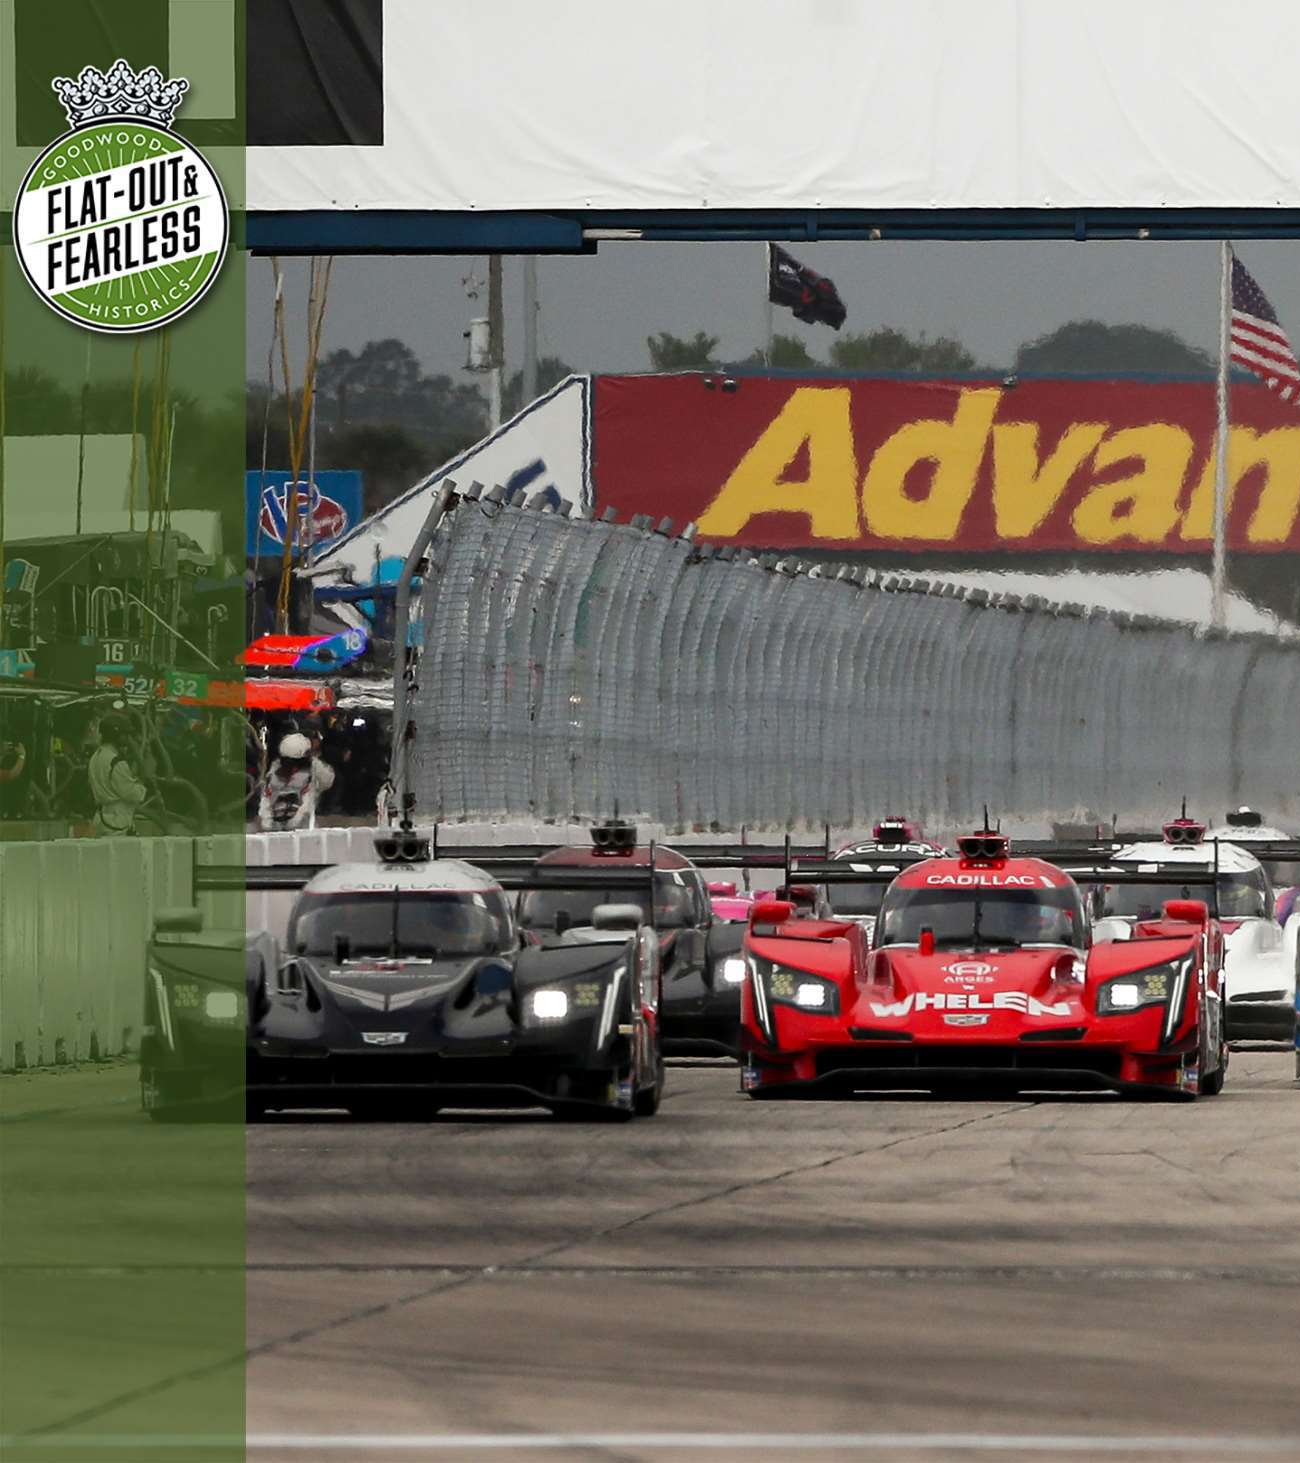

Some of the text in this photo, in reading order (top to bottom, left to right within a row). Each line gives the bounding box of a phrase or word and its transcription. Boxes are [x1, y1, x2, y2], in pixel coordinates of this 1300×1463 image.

[103, 643, 124, 662] 16
[172, 678, 198, 697] 32
[926, 874, 1035, 886] CADILLAC
[869, 991, 1073, 1018] WHELEN
